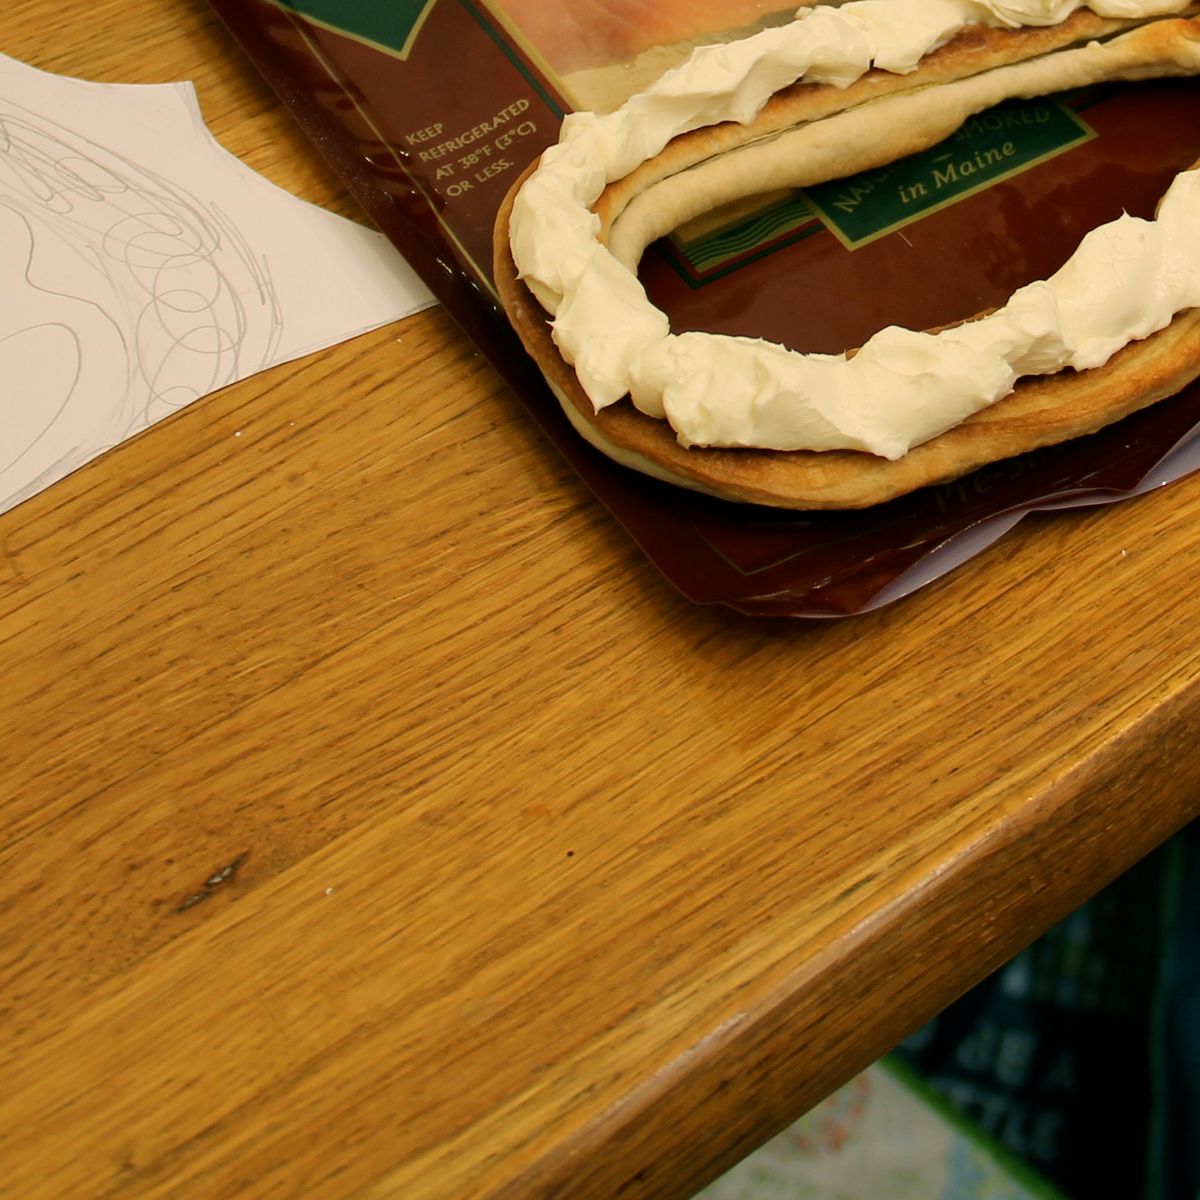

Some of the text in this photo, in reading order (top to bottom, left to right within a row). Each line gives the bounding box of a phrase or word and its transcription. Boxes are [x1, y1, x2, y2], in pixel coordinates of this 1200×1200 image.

[405, 123, 443, 145] KEEP
[418, 98, 530, 162] REFRIGERATED
[435, 163, 455, 180] AT
[446, 158, 515, 197] OR LESS.
[896, 140, 1017, 204] in Maine
